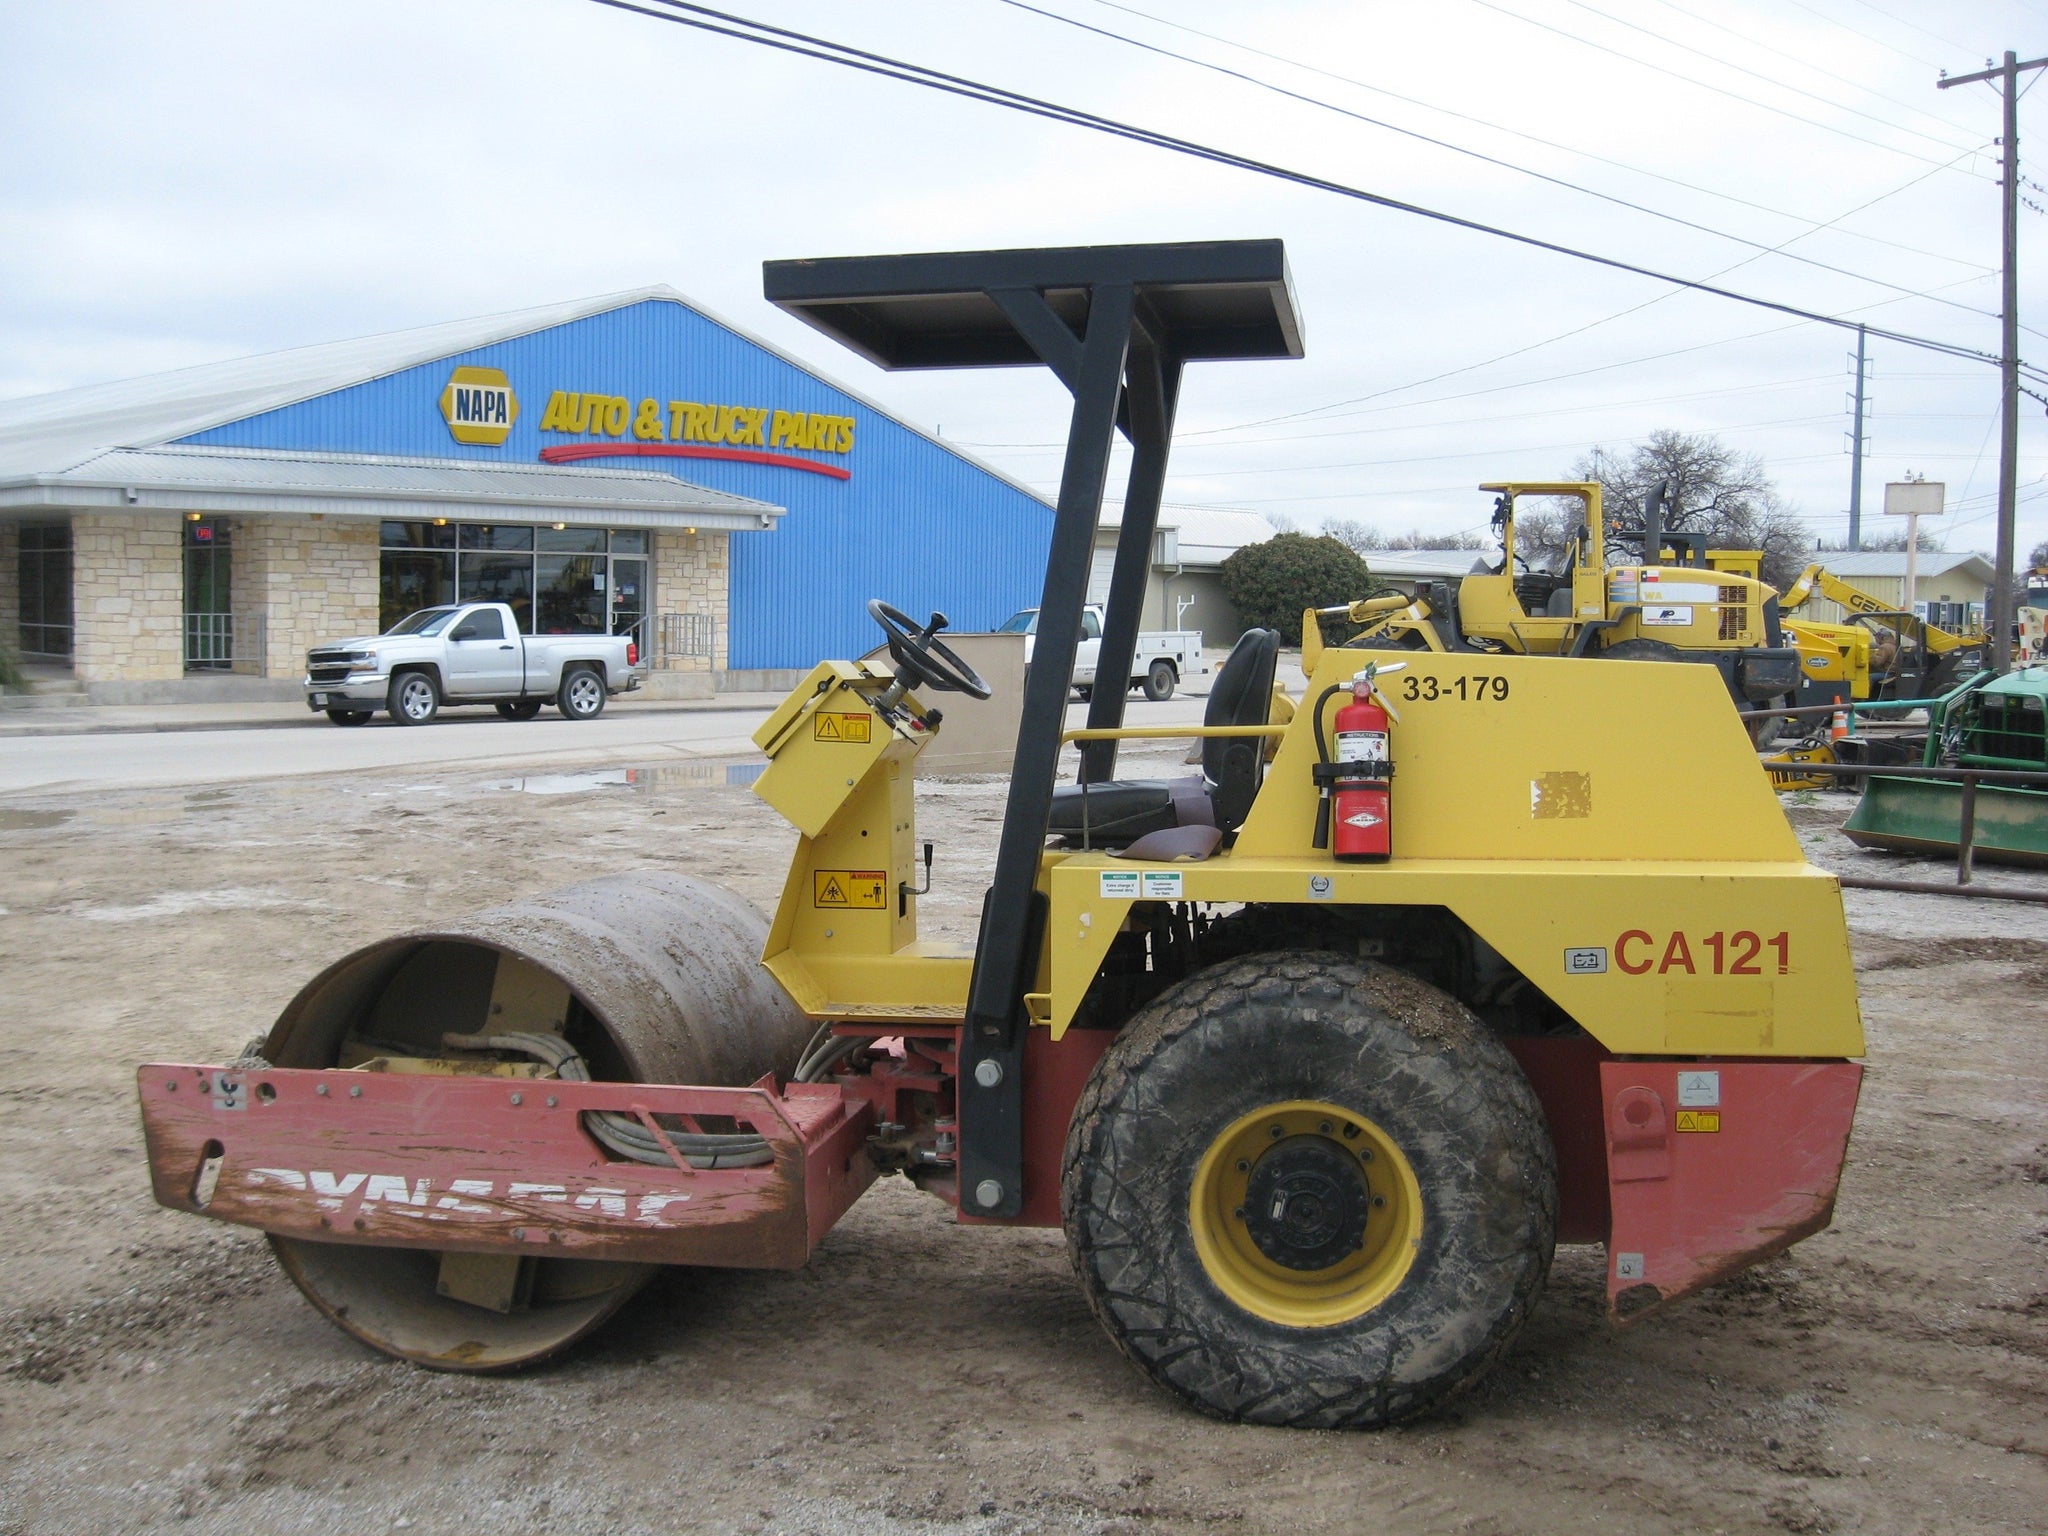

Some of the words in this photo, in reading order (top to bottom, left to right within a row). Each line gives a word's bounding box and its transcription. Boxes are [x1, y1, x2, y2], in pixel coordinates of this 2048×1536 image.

[456, 387, 507, 424] NAPA
[540, 390, 629, 437] AUTO
[633, 398, 663, 441] &
[668, 400, 769, 447] TRUCK
[769, 410, 856, 455] PARTS
[1644, 591, 1663, 600] WA
[1403, 676, 1509, 701] 33-179
[1614, 929, 1789, 975] CA121
